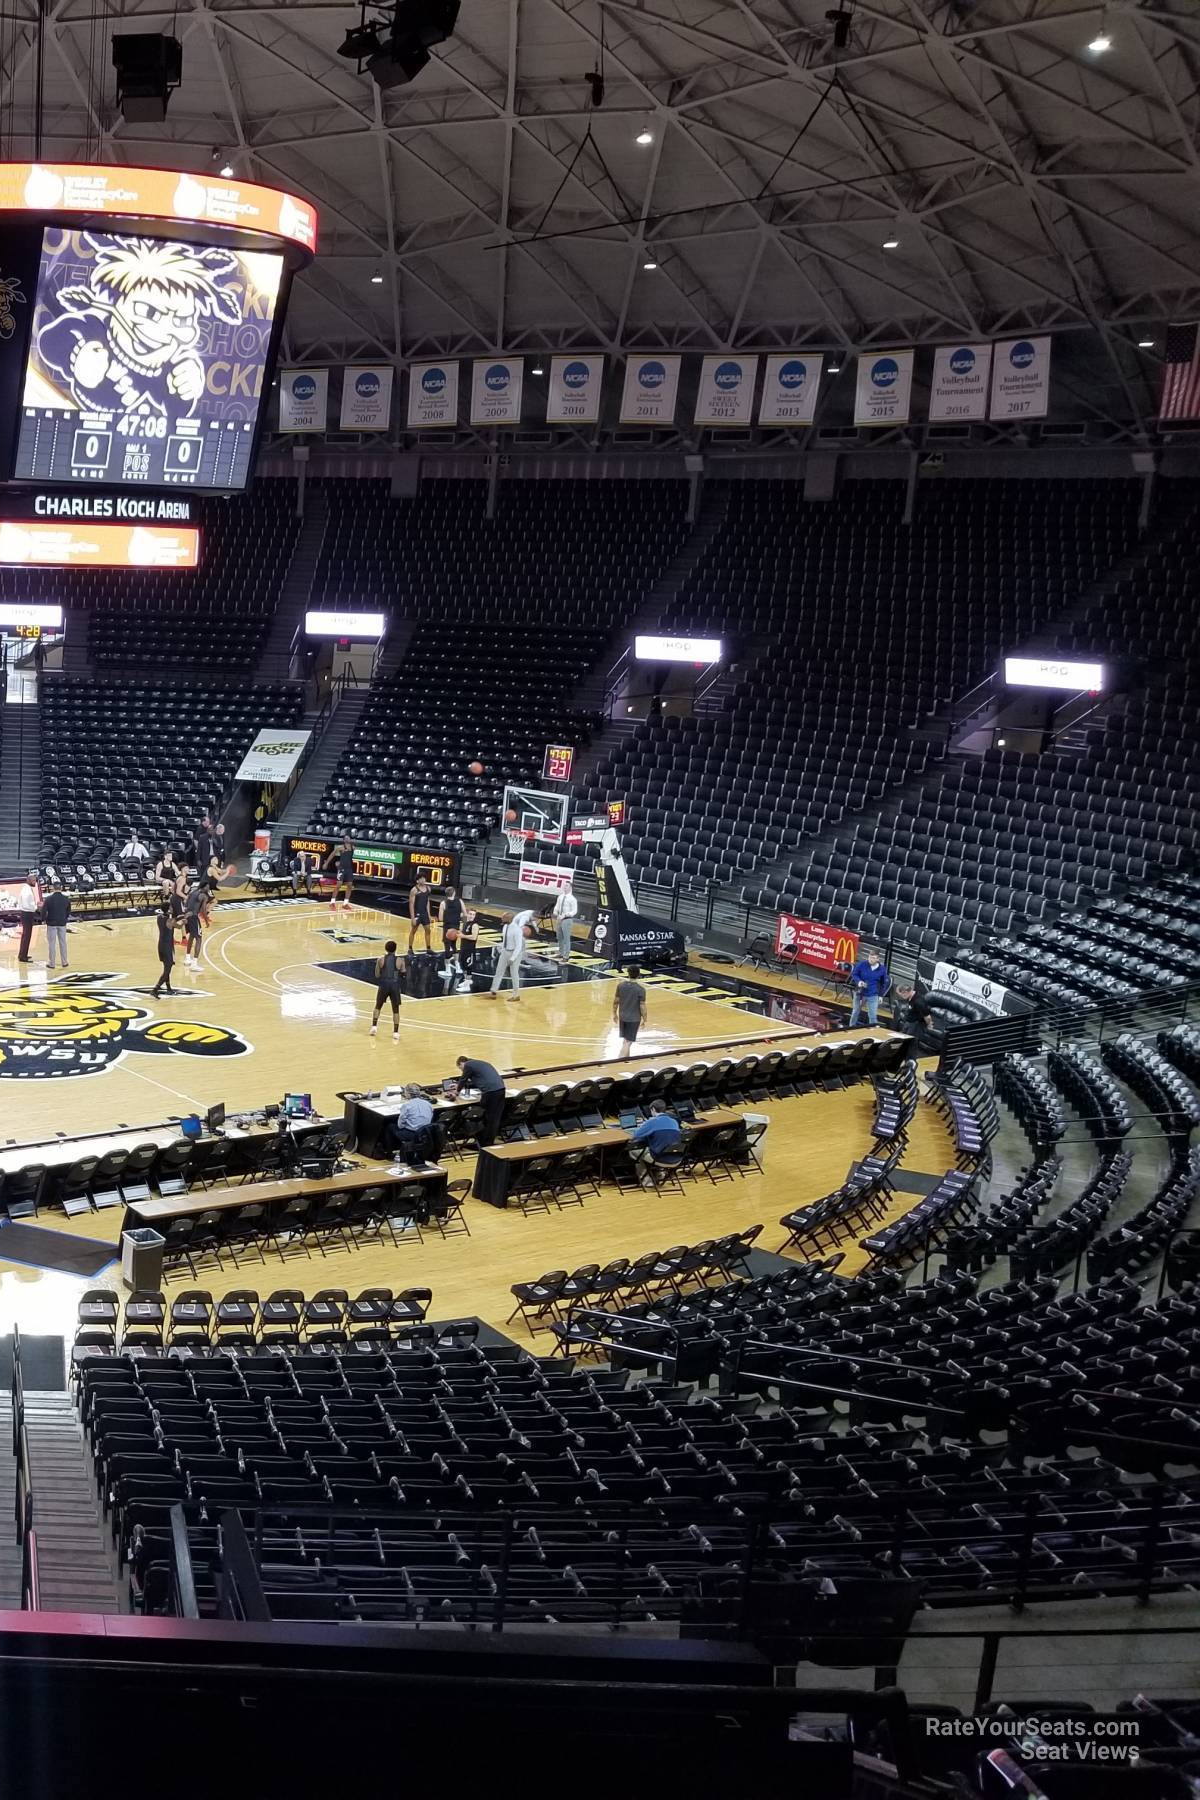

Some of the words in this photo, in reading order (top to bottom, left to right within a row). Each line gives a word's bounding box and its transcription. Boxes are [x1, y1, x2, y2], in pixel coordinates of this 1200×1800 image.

[1012, 353, 1034, 363] NCAA
[951, 360, 975, 369] NCAA
[487, 376, 510, 385] NCAA
[566, 374, 590, 383] NCAA
[640, 374, 665, 383] NCAA
[716, 374, 742, 383] NCAA
[781, 374, 806, 383] NCAA
[873, 372, 898, 381] NCAA
[941, 375, 980, 386] Volleyball
[1003, 373, 1039, 383] Volleyball
[357, 384, 379, 392] NCAA
[424, 380, 446, 388] NCAA
[999, 381, 1043, 391] Tournament
[294, 386, 316, 394] NCAA
[936, 386, 984, 396] Tournament
[485, 407, 508, 417] 2009
[562, 406, 585, 415] 2010
[636, 406, 659, 416] 2011
[711, 408, 735, 417] 2012
[776, 407, 800, 417] 2013
[871, 407, 895, 417] 2015
[945, 405, 970, 415] 2016
[1007, 402, 1031, 413] 2017
[355, 414, 376, 423] 2007
[422, 410, 444, 420] 2008
[292, 416, 313, 425] 2004
[116, 415, 168, 438] 47:08
[85, 435, 99, 458] 0
[177, 441, 191, 463] 0
[123, 455, 149, 472] POS
[35, 495, 113, 516] CHARLES
[116, 498, 155, 517] KOCH
[156, 500, 190, 519] ARENA
[16, 625, 40, 637] 4:28
[550, 749, 571, 760] 47:07
[550, 760, 567, 777] 23
[290, 840, 327, 852] SHOCKERS
[370, 851, 396, 859] DENTAL
[410, 853, 450, 866] BEARCATS
[431, 870, 441, 883] 0
[520, 868, 572, 888] ESPN
[595, 866, 609, 906] WSU
[619, 933, 647, 942] KANSAS
[656, 932, 675, 940] STAR
[813, 942, 835, 953] Shocker
[8, 1046, 109, 1064] WSU
